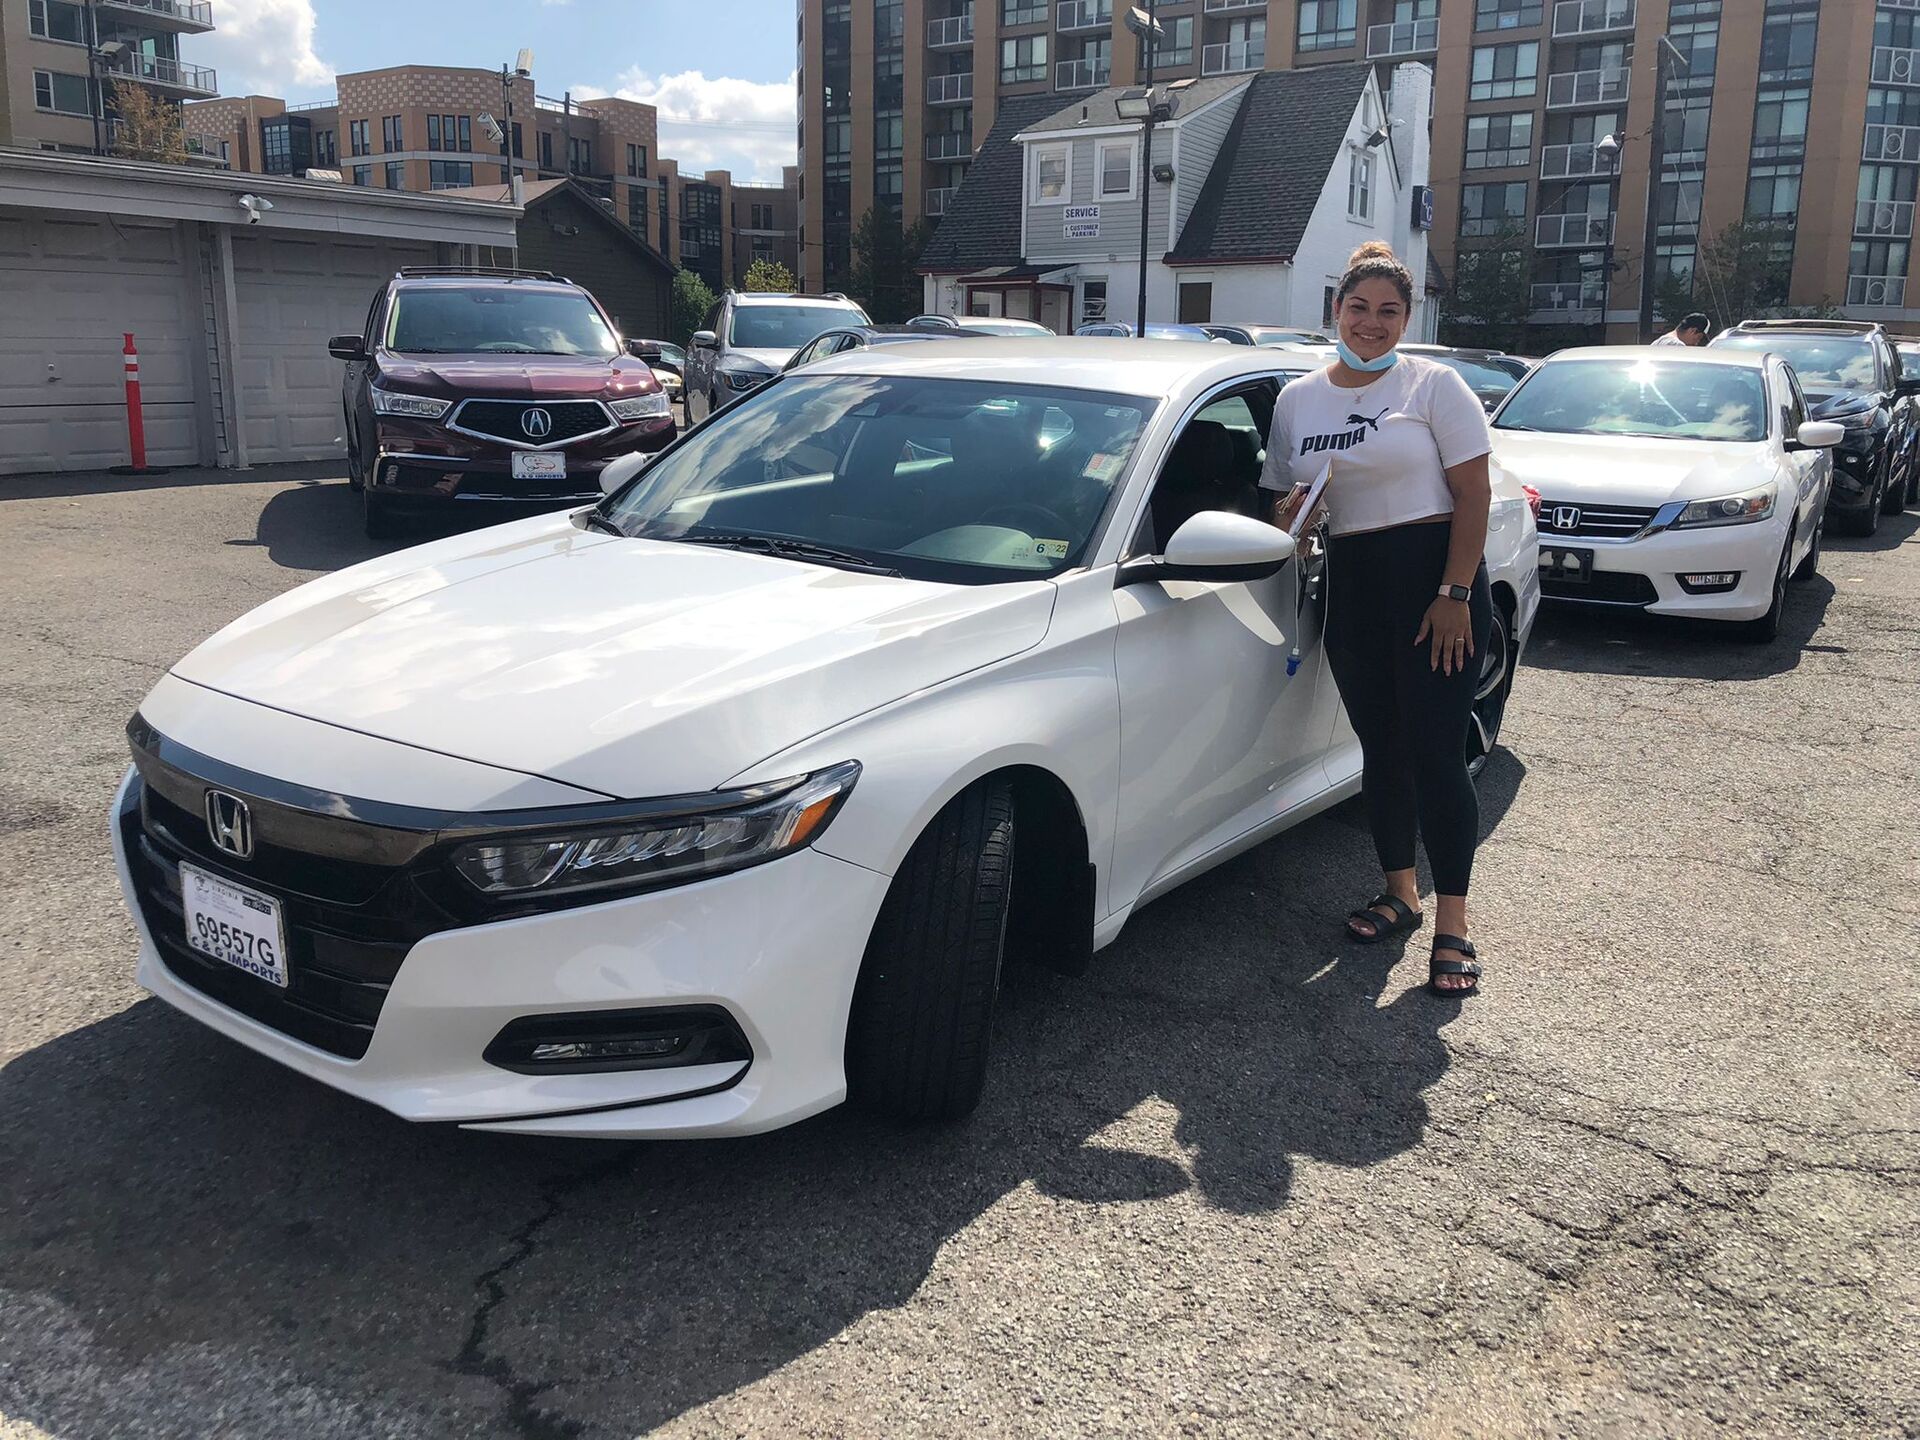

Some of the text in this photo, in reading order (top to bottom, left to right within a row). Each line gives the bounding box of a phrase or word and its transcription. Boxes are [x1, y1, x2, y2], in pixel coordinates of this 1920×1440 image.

[1065, 207, 1099, 218] SERVICE
[1300, 425, 1367, 457] PUMA
[1036, 543, 1046, 554] 6
[1056, 545, 1067, 554] 22
[195, 912, 275, 967] 69557G
[191, 936, 282, 984] C & G IMPORTS
